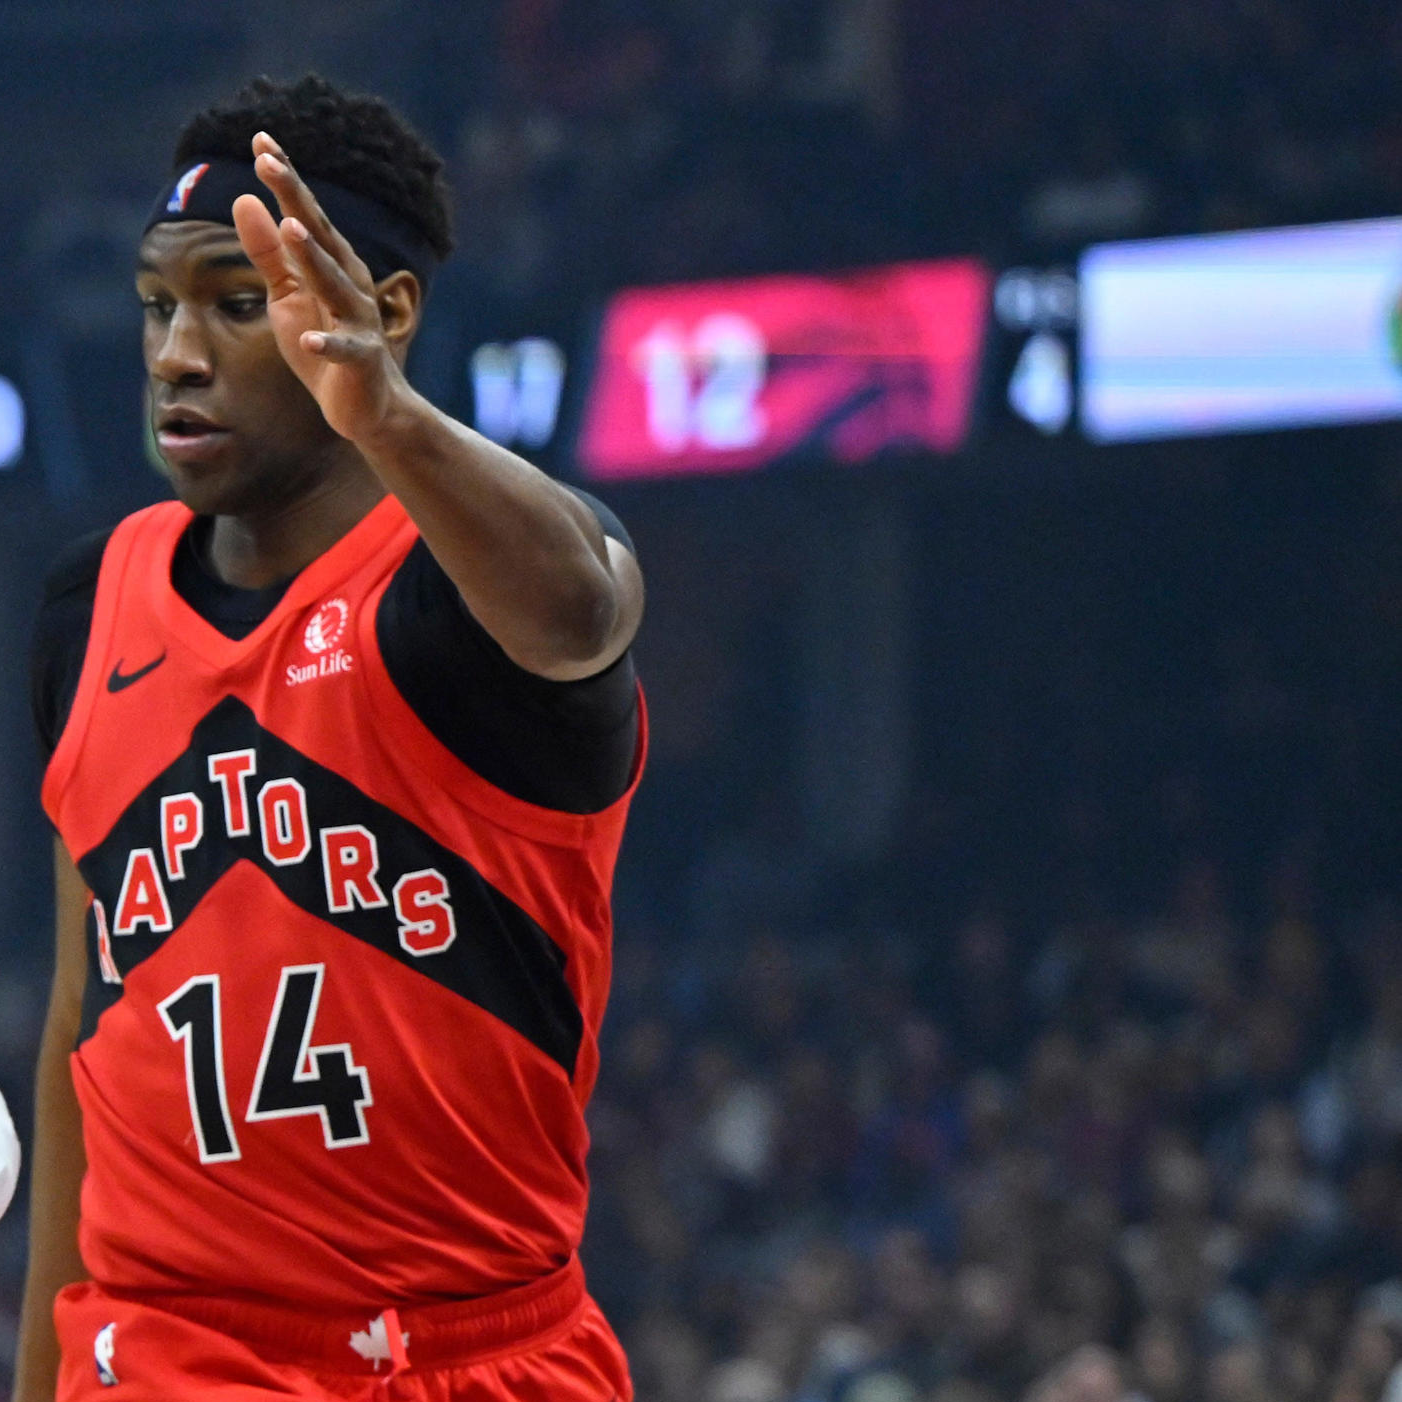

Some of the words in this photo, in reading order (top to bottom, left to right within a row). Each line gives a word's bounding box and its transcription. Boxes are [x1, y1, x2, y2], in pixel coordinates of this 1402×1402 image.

[630, 314, 766, 450] 12
[286, 664, 318, 688] Sun
[319, 649, 353, 677] Life
[157, 963, 373, 1163] 14
